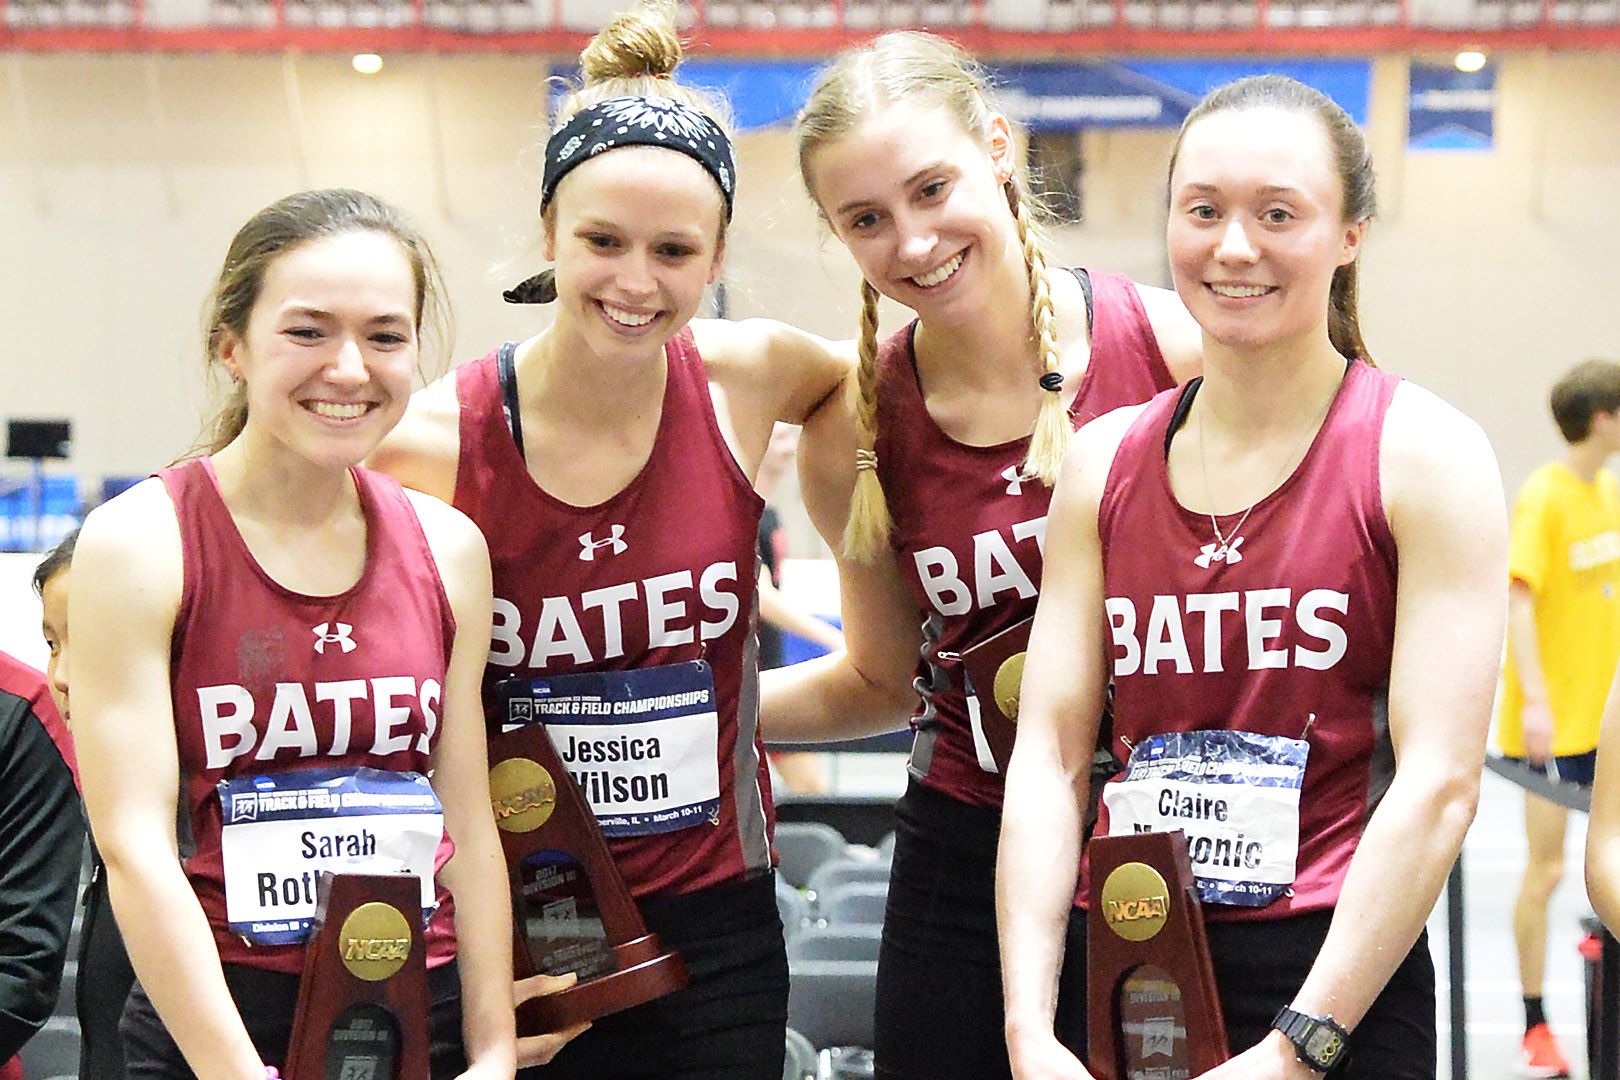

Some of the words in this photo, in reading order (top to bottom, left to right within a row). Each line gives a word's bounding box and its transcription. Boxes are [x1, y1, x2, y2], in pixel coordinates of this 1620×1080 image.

[489, 561, 739, 668] BATES
[1105, 587, 1350, 676] BATES
[534, 702, 570, 714] TRACK
[581, 702, 611, 714] FIELD
[613, 689, 710, 715] CHAMPIONSHIPS
[196, 676, 442, 770] BATES
[562, 735, 661, 763] Jessica
[653, 810, 680, 823] March
[680, 805, 703, 817] 10-11
[1158, 788, 1228, 822] Claire
[301, 829, 376, 859] Sarah
[1248, 884, 1273, 896] 10-11
[1109, 895, 1165, 921] NCAA
[345, 938, 409, 961] NCAA
